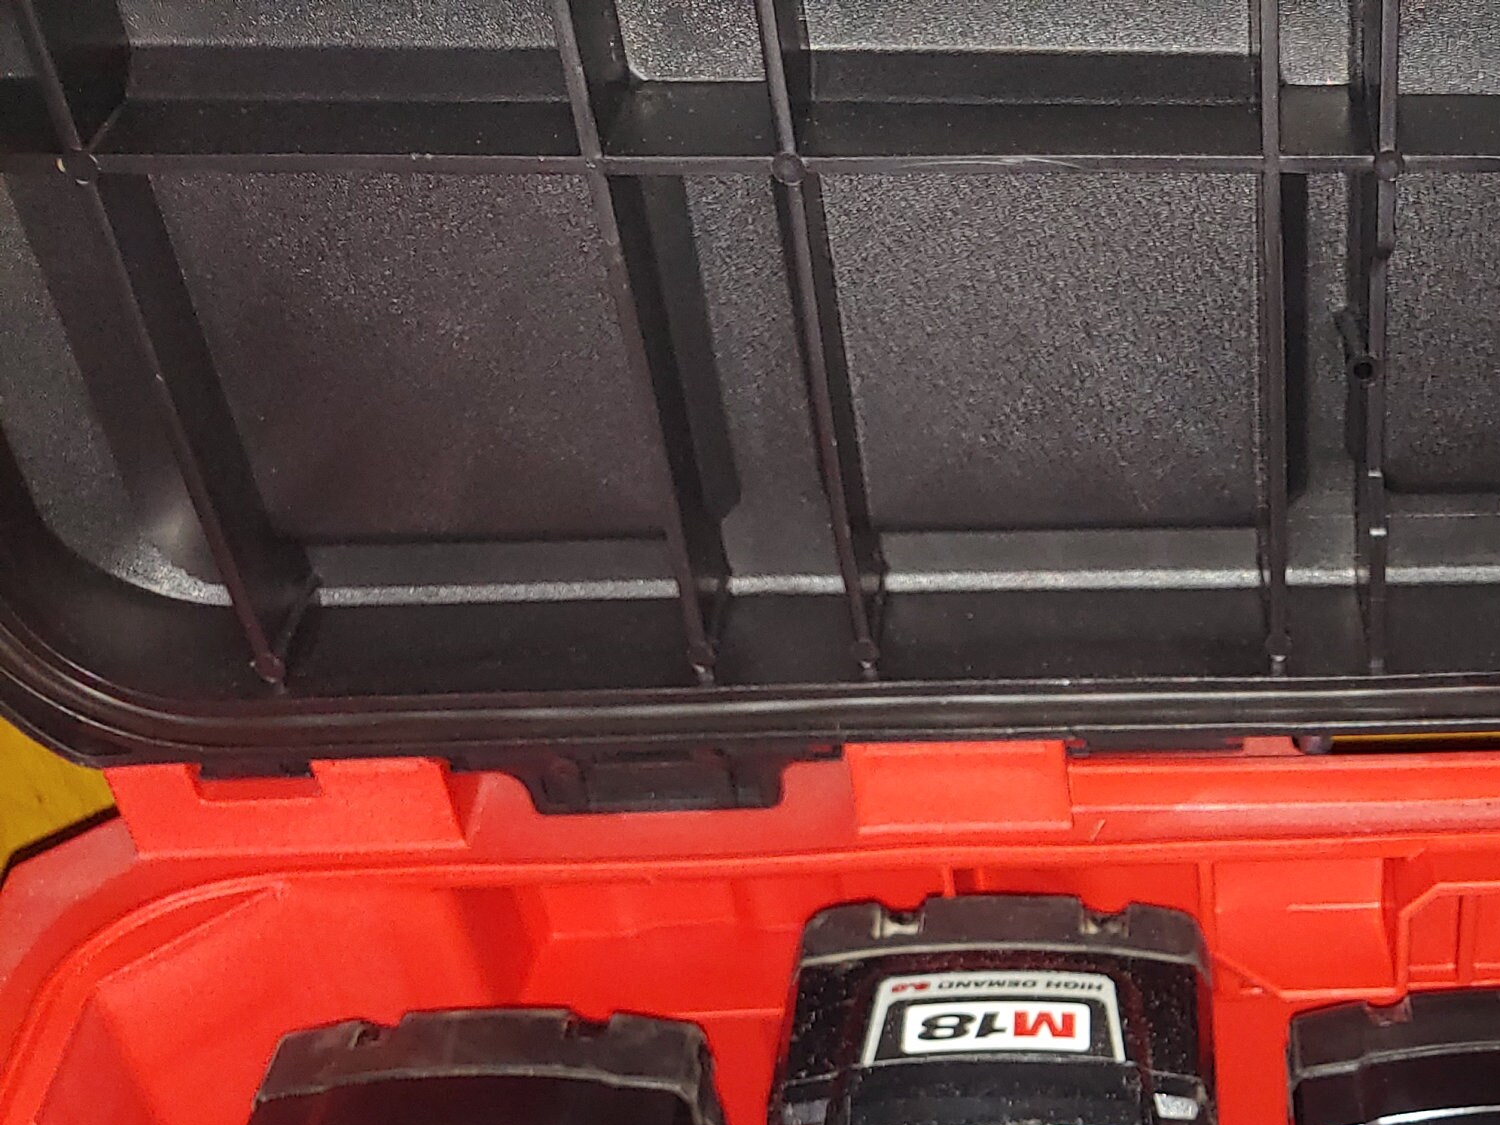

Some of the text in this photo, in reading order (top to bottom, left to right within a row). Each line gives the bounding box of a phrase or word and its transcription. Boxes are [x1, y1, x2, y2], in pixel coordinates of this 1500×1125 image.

[937, 978, 1039, 991] DEMAND
[1045, 979, 1104, 992] HIGH
[917, 1010, 1077, 1041] M18
